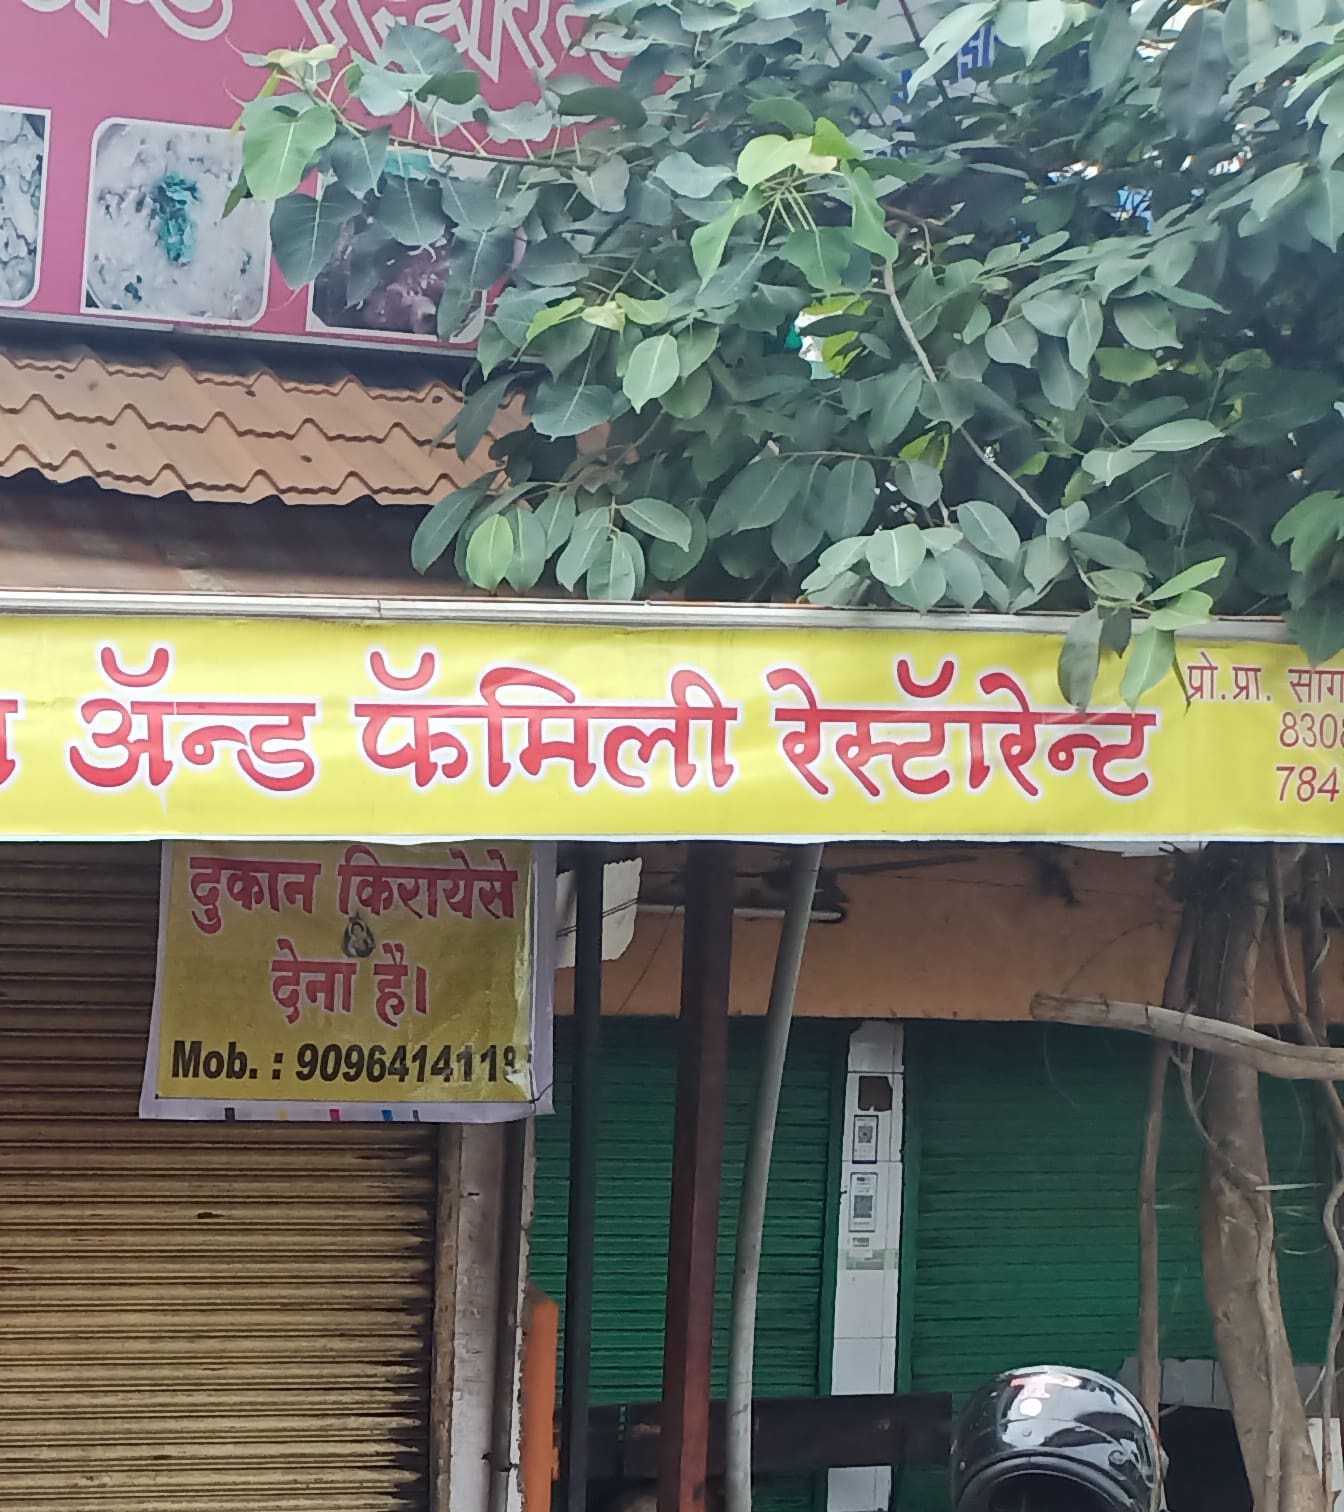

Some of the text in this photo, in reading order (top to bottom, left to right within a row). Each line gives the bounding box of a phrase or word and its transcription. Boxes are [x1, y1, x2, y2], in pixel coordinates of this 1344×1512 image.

[353, 649, 738, 790] फॅमिली
[1279, 711, 1344, 750] 830
[189, 843, 519, 935] दुकान किरायेसे
[271, 938, 358, 1025] देना
[171, 1039, 259, 1081] Mob.
